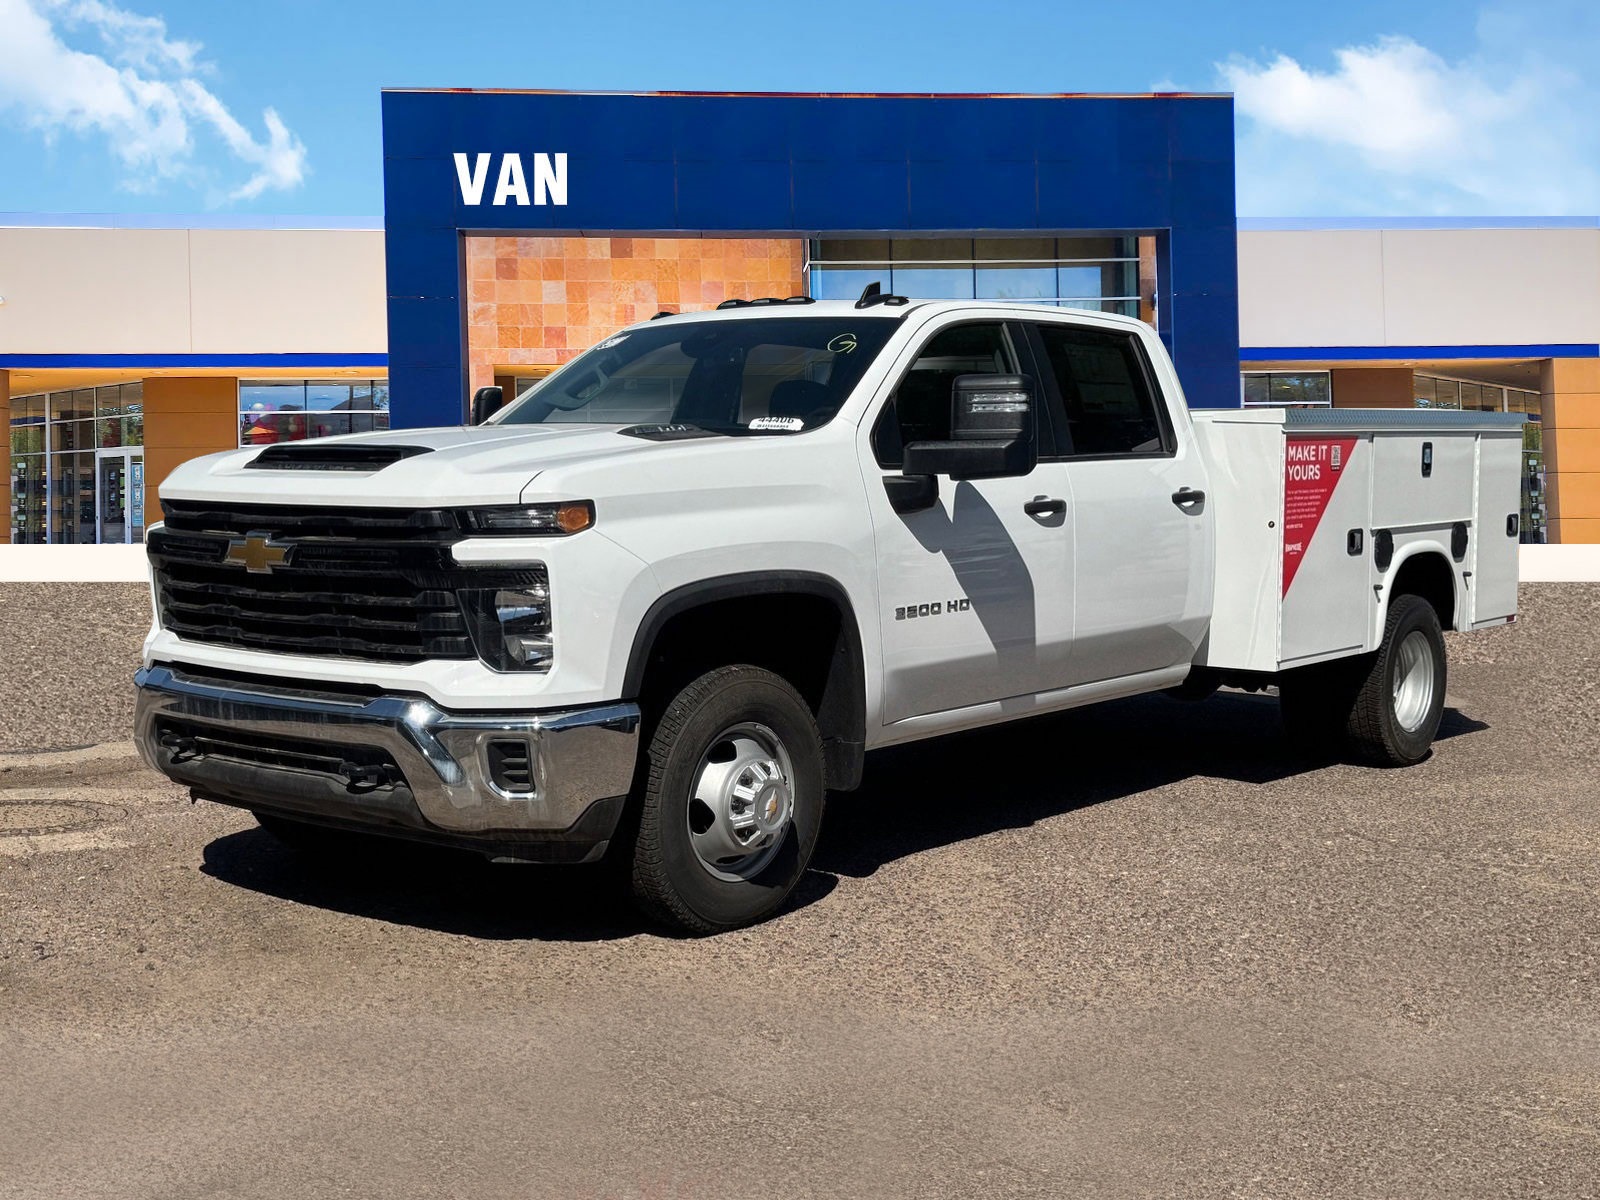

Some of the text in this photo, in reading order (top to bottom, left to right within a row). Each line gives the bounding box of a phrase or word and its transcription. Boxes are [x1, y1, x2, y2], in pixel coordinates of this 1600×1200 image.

[453, 153, 567, 205] VAN
[1288, 445, 1327, 461] MAKE IT
[1288, 464, 1320, 481] YOURS
[947, 599, 970, 613] HD
